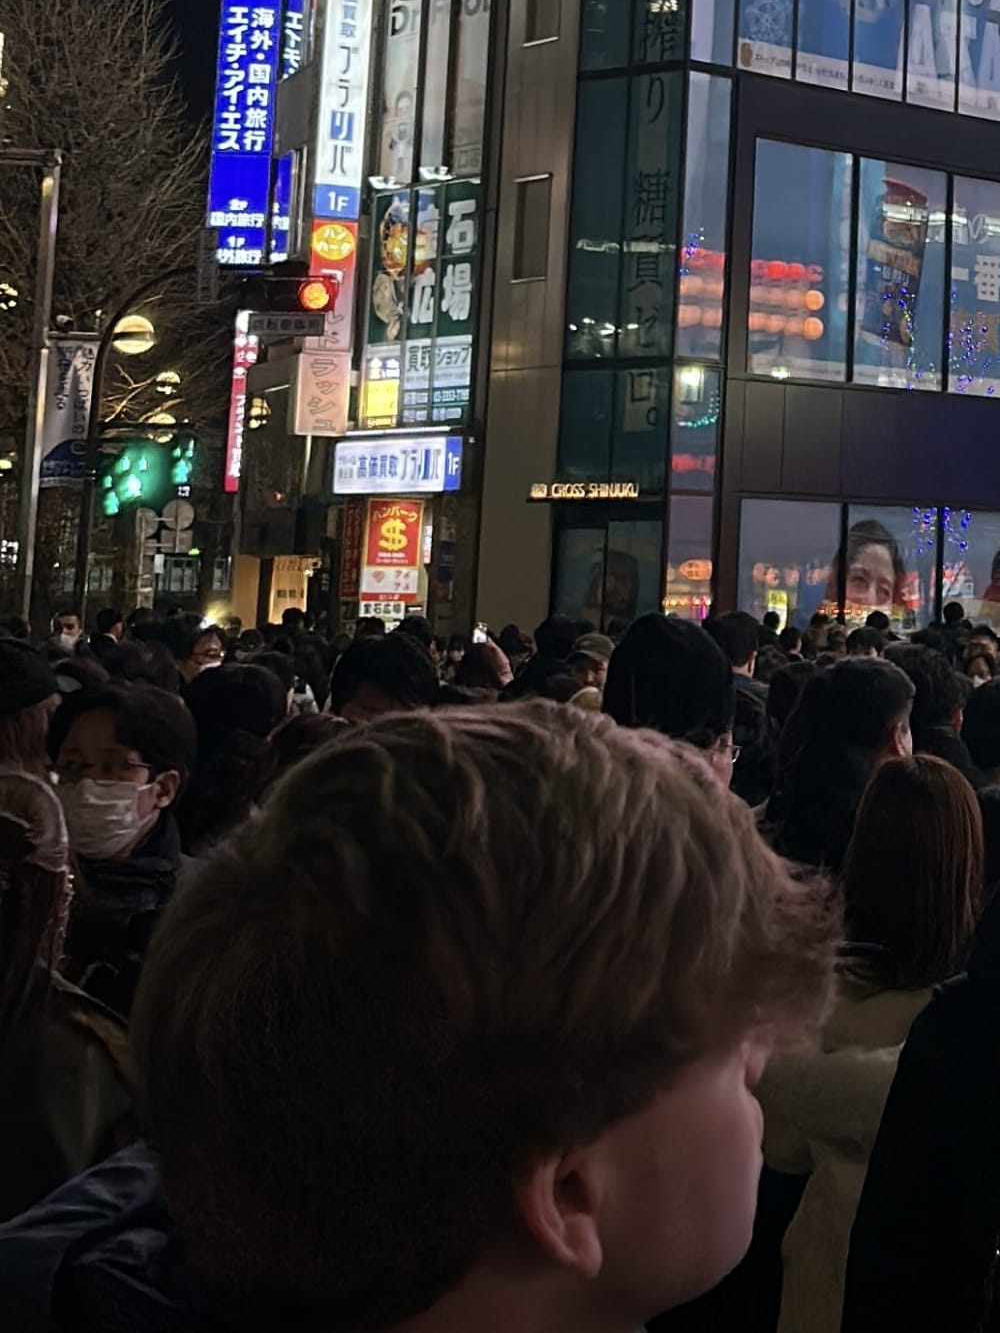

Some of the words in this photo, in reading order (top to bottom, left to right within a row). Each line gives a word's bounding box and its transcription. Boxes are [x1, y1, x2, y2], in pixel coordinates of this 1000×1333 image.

[217, 6, 250, 152] エイチ・アイ・エス
[243, 7, 276, 152] 海外・国内旅行
[328, 45, 359, 176] ブラリバ
[328, 191, 349, 212] 1F
[411, 262, 472, 324] 広場
[448, 452, 460, 476] 1F
[551, 482, 586, 498] CROSS
